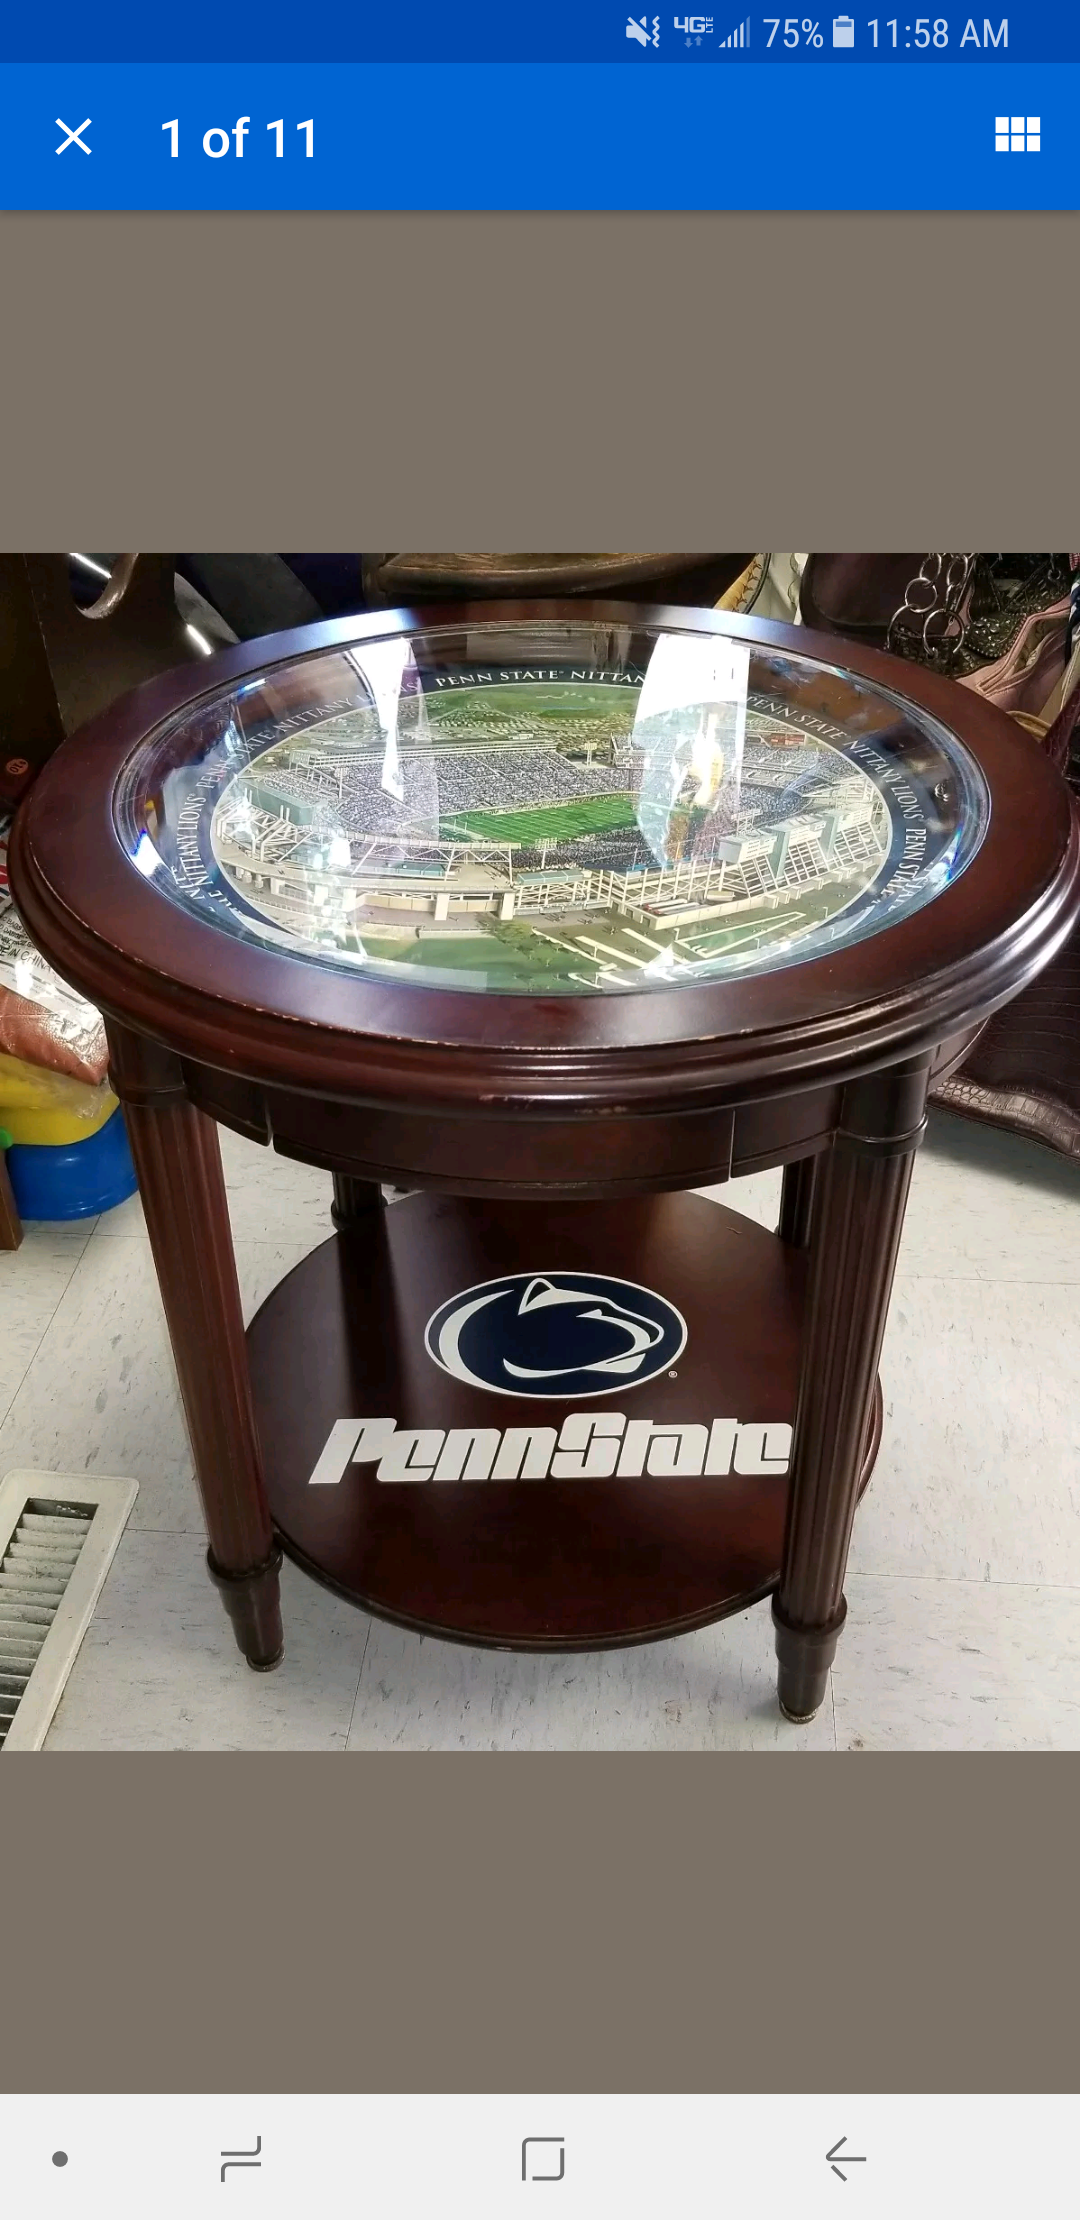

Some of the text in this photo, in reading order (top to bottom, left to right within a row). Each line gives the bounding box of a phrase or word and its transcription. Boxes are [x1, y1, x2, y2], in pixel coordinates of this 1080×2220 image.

[764, 19, 823, 47] 75%
[868, 19, 948, 47] 11:58
[960, 19, 1007, 47] AM
[162, 117, 313, 158] 1 of 11
[436, 673, 493, 687] PENN
[500, 670, 560, 680] STATE
[570, 671, 647, 683] NITTAN
[273, 697, 354, 733] NITTANY
[746, 696, 797, 718] PENN
[794, 714, 848, 740] STATE
[843, 740, 905, 783] NITTANY
[178, 796, 206, 832] LIONS
[891, 783, 924, 820] LIONS
[902, 828, 927, 861] PENN
